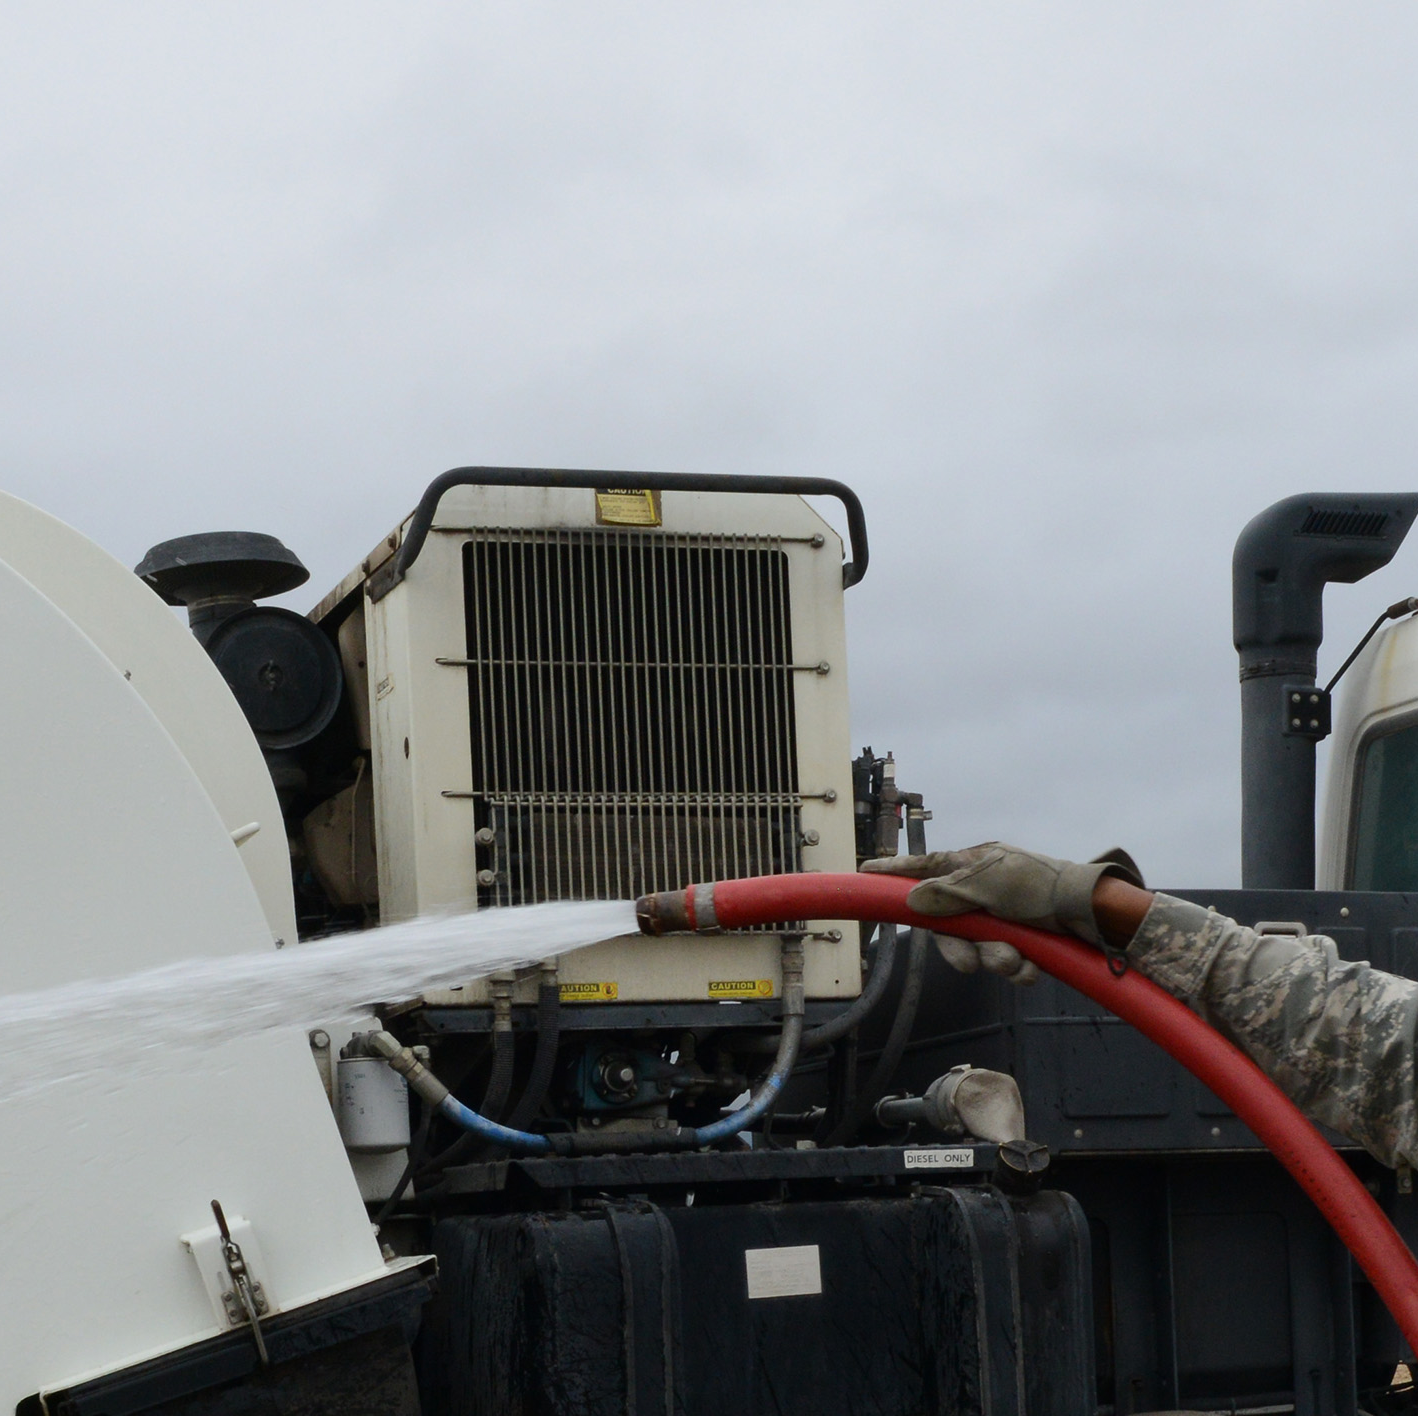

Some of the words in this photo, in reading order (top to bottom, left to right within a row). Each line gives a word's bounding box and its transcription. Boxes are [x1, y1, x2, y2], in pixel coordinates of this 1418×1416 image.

[561, 984, 598, 992] AUTION
[711, 982, 754, 990] CAUTION
[907, 1154, 939, 1164] DIESEL
[944, 1154, 971, 1163] ONLY
